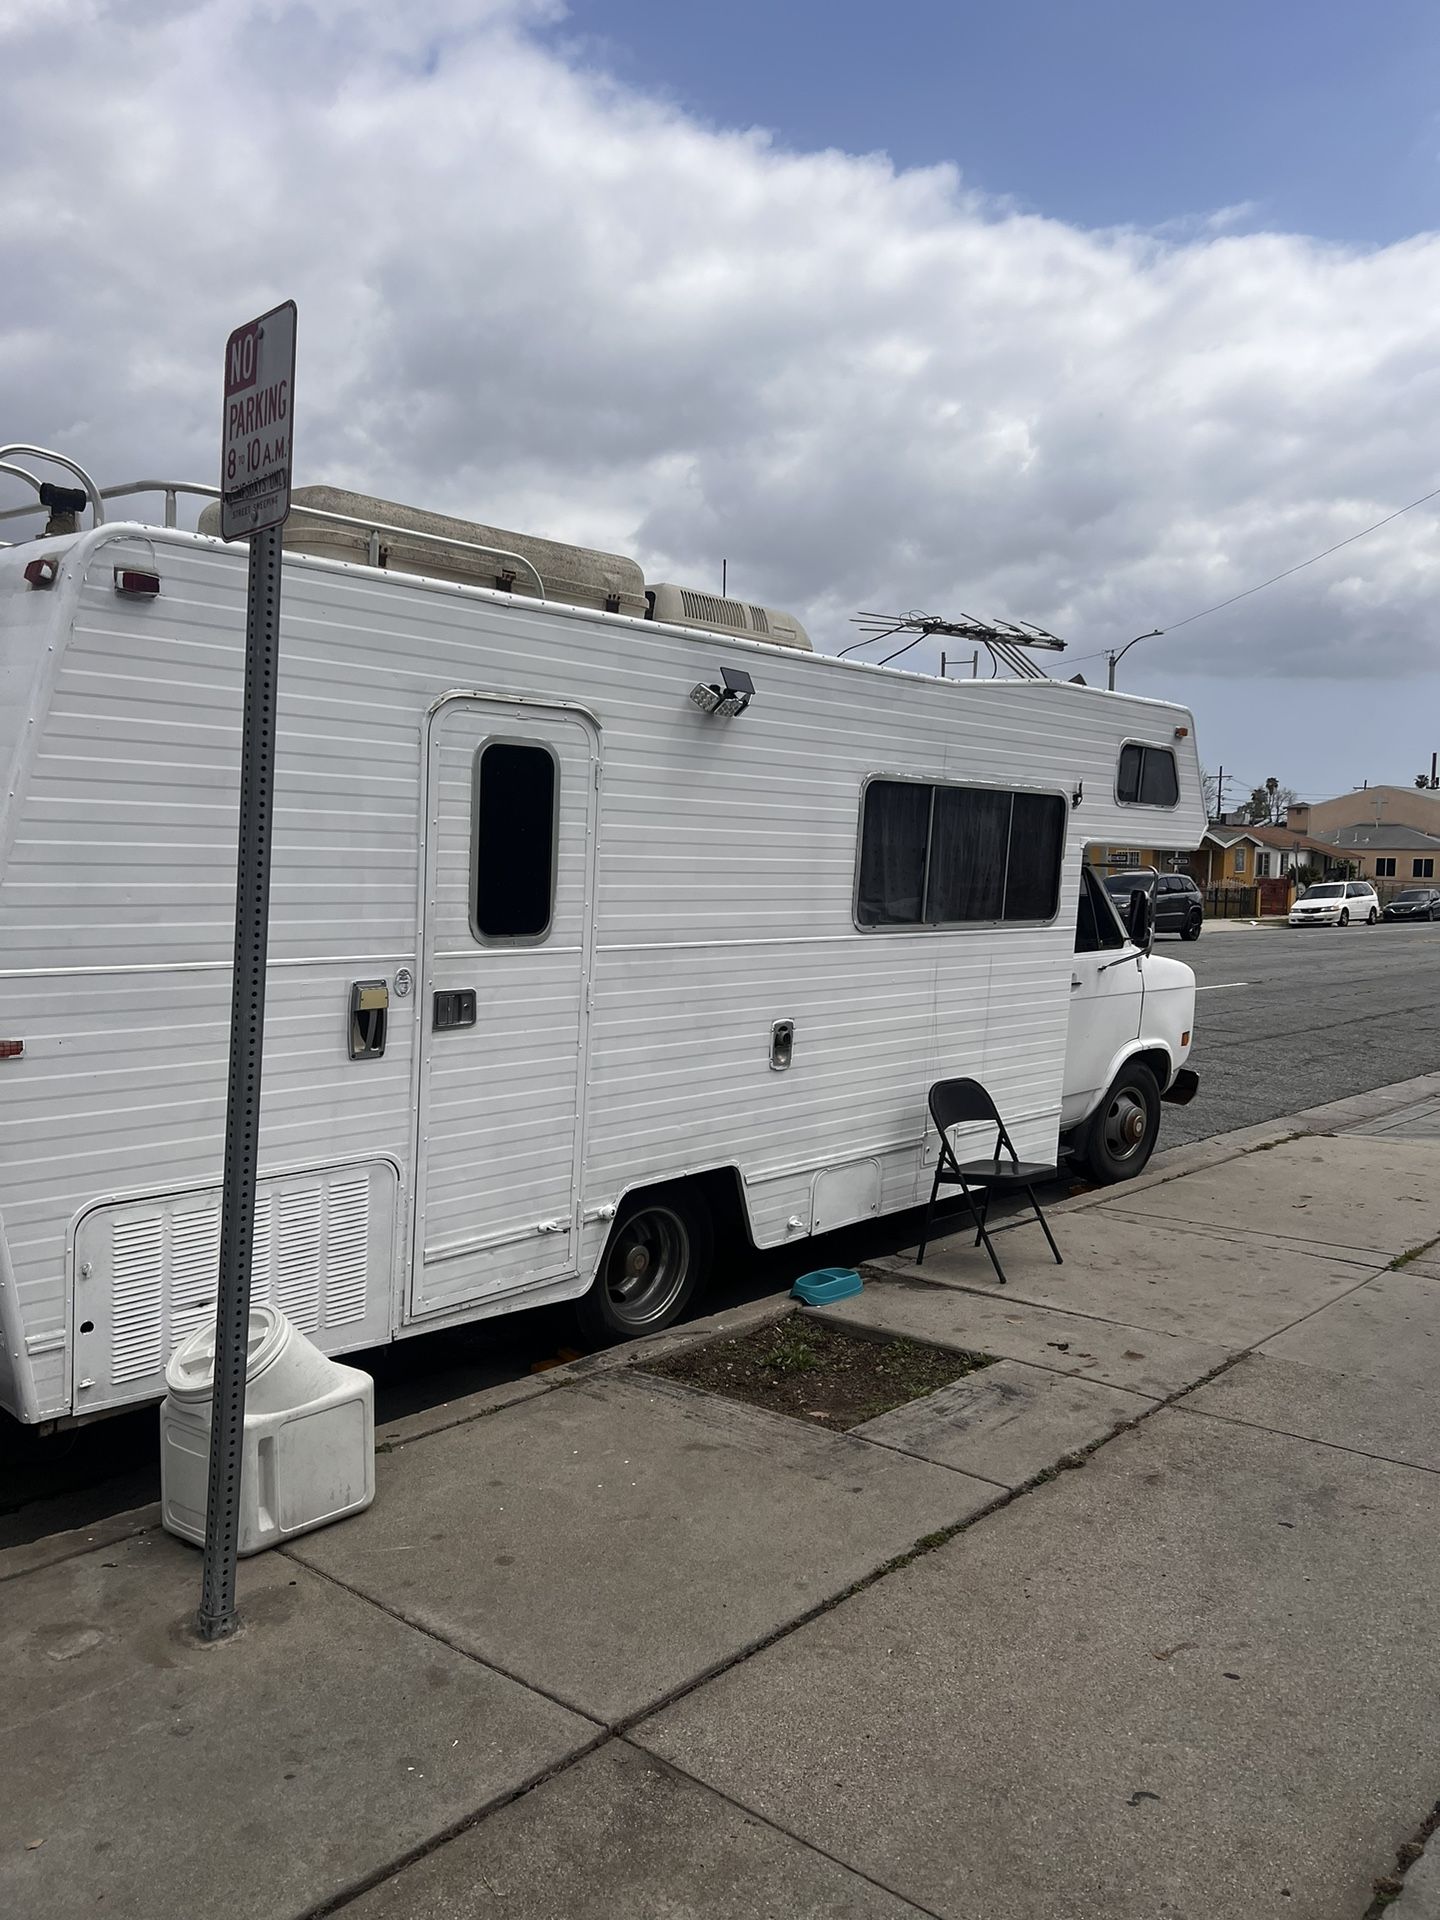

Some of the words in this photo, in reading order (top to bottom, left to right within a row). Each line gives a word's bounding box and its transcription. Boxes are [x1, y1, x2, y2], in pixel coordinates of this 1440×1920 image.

[230, 334, 254, 386] NO
[230, 380, 287, 441] PARKING
[227, 448, 236, 479] 8
[247, 438, 260, 473] 10
[262, 436, 288, 467] A.M.
[231, 505, 251, 519] STREET
